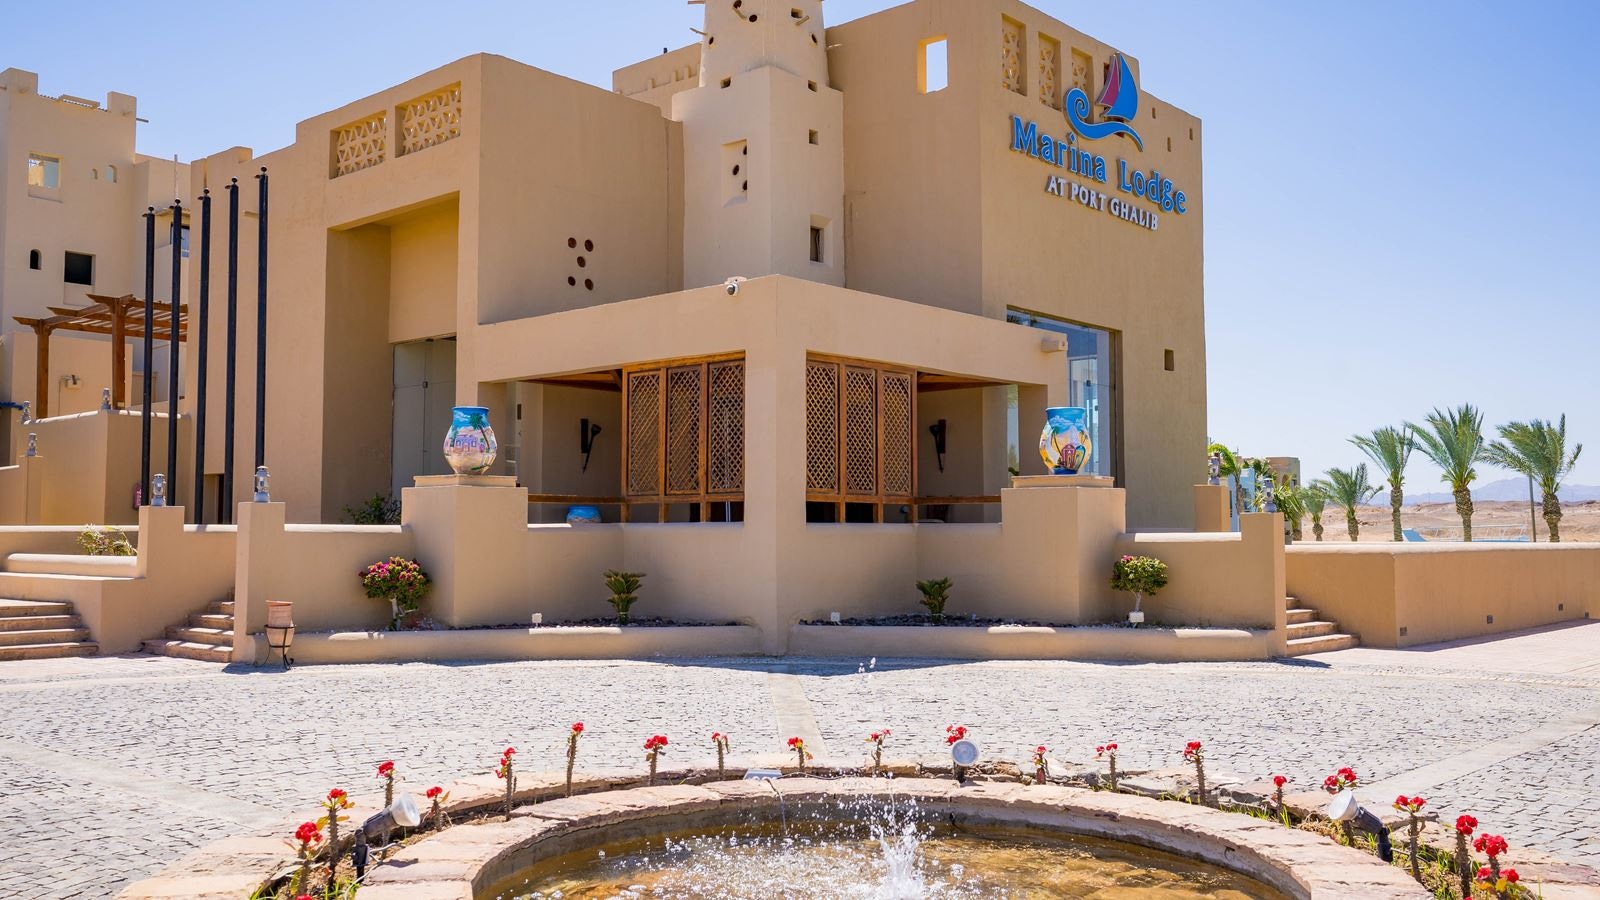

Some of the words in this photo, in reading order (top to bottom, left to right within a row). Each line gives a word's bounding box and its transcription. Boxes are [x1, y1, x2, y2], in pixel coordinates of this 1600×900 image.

[1011, 115, 1107, 184] Marina
[1117, 159, 1187, 214] Lodge
[1048, 176, 1066, 197] AT
[1071, 185, 1106, 212] PORT
[1110, 198, 1158, 231] GHALIB
